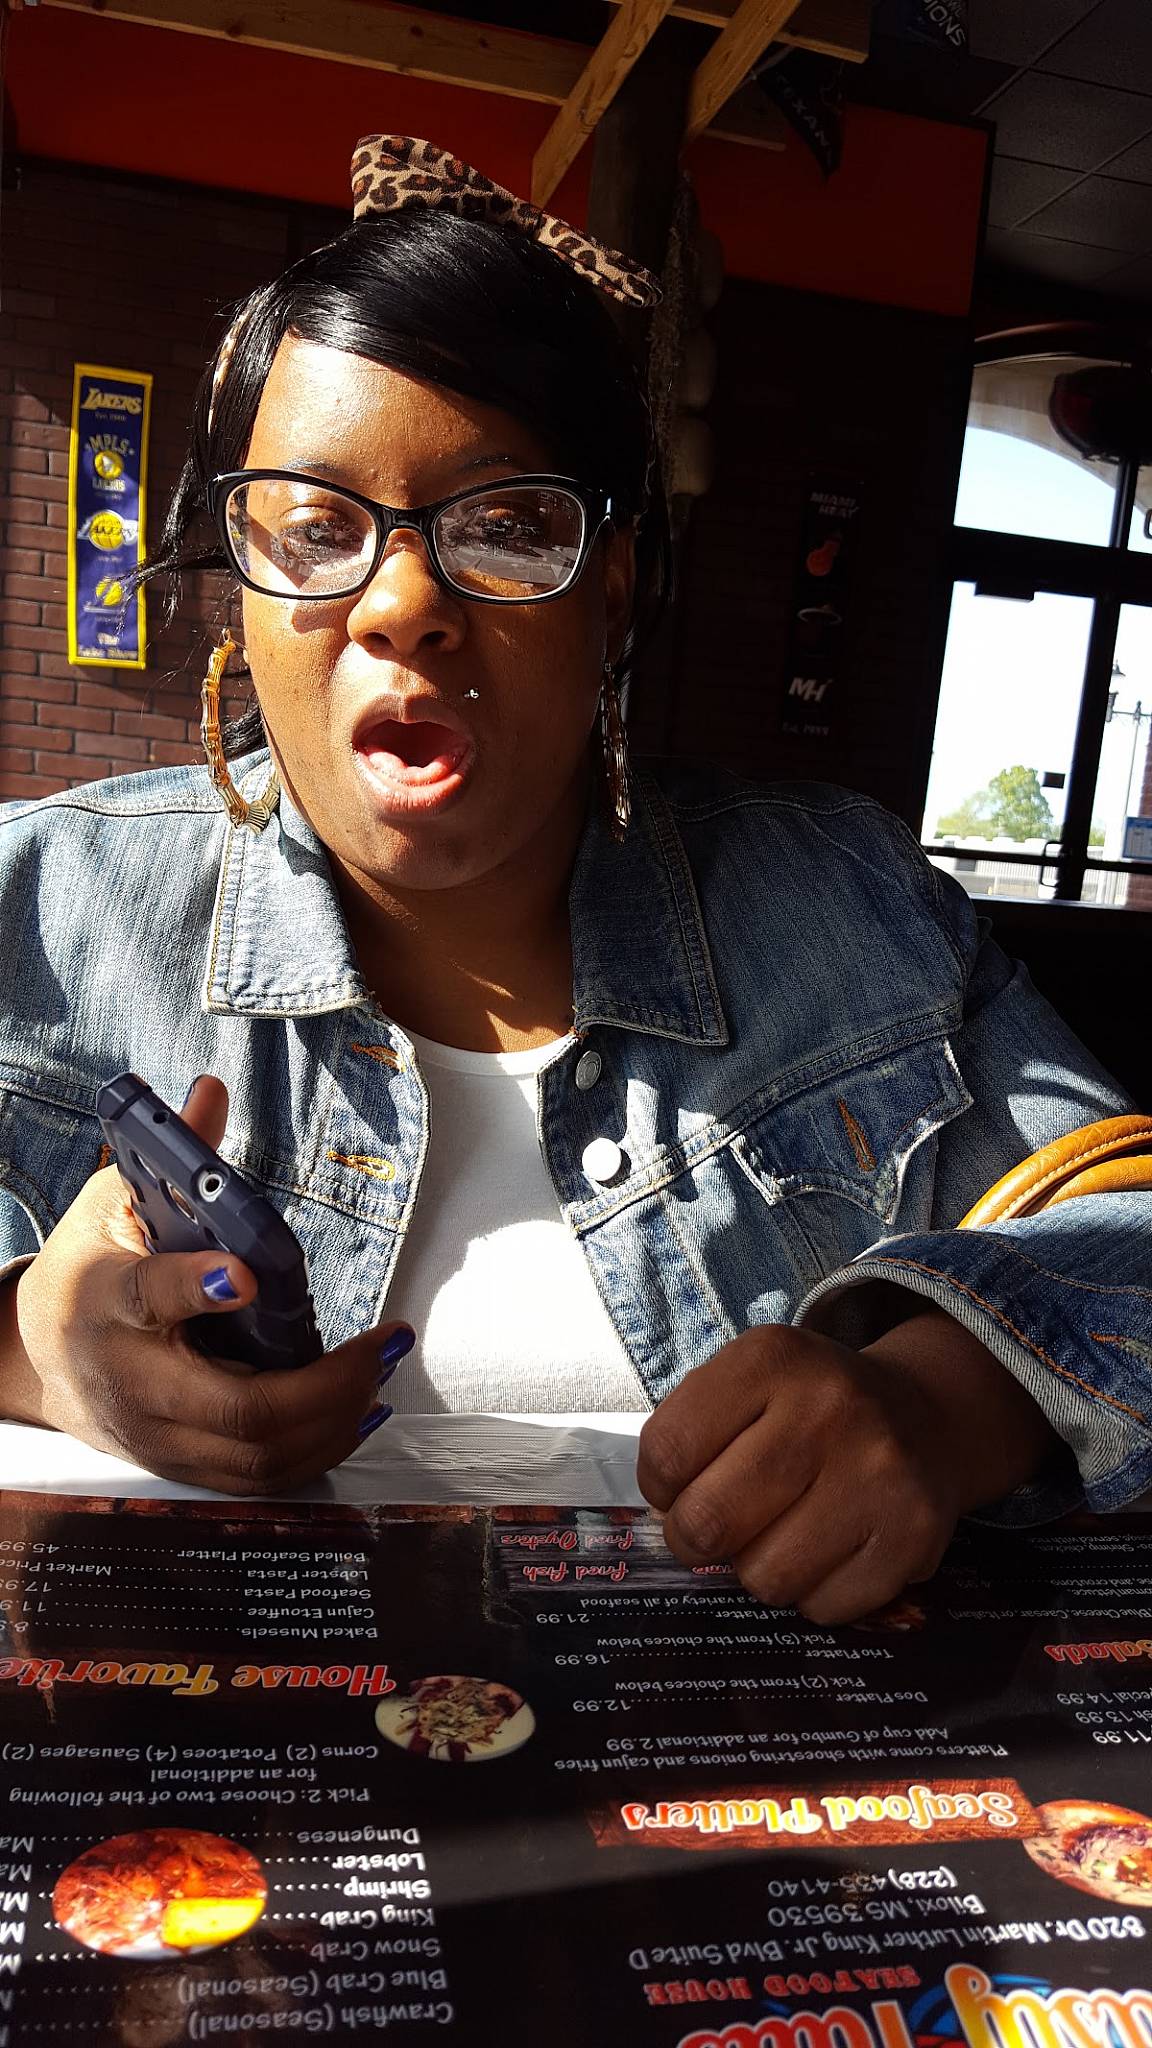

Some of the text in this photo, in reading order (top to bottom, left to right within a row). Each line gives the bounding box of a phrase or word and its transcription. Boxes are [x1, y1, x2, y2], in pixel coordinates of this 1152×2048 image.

[81, 387, 142, 415] LAKERS
[0, 1540, 366, 1562] Boiled Seafood Platter 45.99
[45, 1562, 112, 1576] Market
[246, 1570, 298, 1580] Pasta
[302, 1570, 368, 1580] Lobster
[244, 1588, 296, 1599] Pasta
[300, 1588, 372, 1600] Seafood
[642, 1597, 660, 1608] all
[662, 1596, 679, 1607] of
[682, 1595, 734, 1608] variety
[736, 1596, 744, 1604] a
[0, 1599, 374, 1619] Cajun Etouffee 11.9
[580, 1598, 640, 1609] seafood
[536, 1612, 590, 1624] 21.99
[714, 1610, 768, 1620] Platter
[0, 1620, 378, 1638] Baked Mussels 8.9
[596, 1632, 836, 1648] Pick (3) from the choices below
[554, 1648, 893, 1666] Trio Platter 16.99
[230, 1664, 397, 1696] House
[614, 1674, 866, 1692] Pick (2) from the choices below
[572, 1691, 928, 1712] Dos Platter 12.99
[1056, 1692, 1112, 1704] 14.99
[1075, 1710, 1133, 1724] 13.99
[606, 1725, 948, 1751] Add cup of Gumbo for an additional 2.99
[1092, 1730, 1152, 1744] 11.99
[2, 1742, 378, 1762] Corns (2) Potatoes (4) Sausages (2)
[554, 1744, 1008, 1772] Platters come with shoestring onions and cajun fries
[150, 1768, 317, 1782] for an additional
[8, 1787, 102, 1806] following
[108, 1790, 145, 1805] the
[147, 1790, 171, 1805] of
[176, 1790, 216, 1804] two
[220, 1789, 296, 1804] Choose
[326, 1787, 370, 1802] Pick
[621, 1785, 1018, 1834] Seafood Platters
[296, 1825, 420, 1844] Dungeness
[331, 1852, 426, 1872] Lobster
[342, 1876, 432, 1900] Shrimp
[319, 1904, 435, 1930] King Crab
[768, 1894, 985, 1927] Biloxi, MS 39530
[310, 1938, 441, 1962] Snow Crab
[628, 1914, 1146, 1970] 820 Dr. Martin Luther King Jr. Blvd Suite D
[177, 1968, 448, 2004] Blue Crab (Seasonal)
[644, 1965, 920, 2005] SEAFOOD HOUSE
[188, 2002, 454, 2040] Crawfish (Seasonal)
